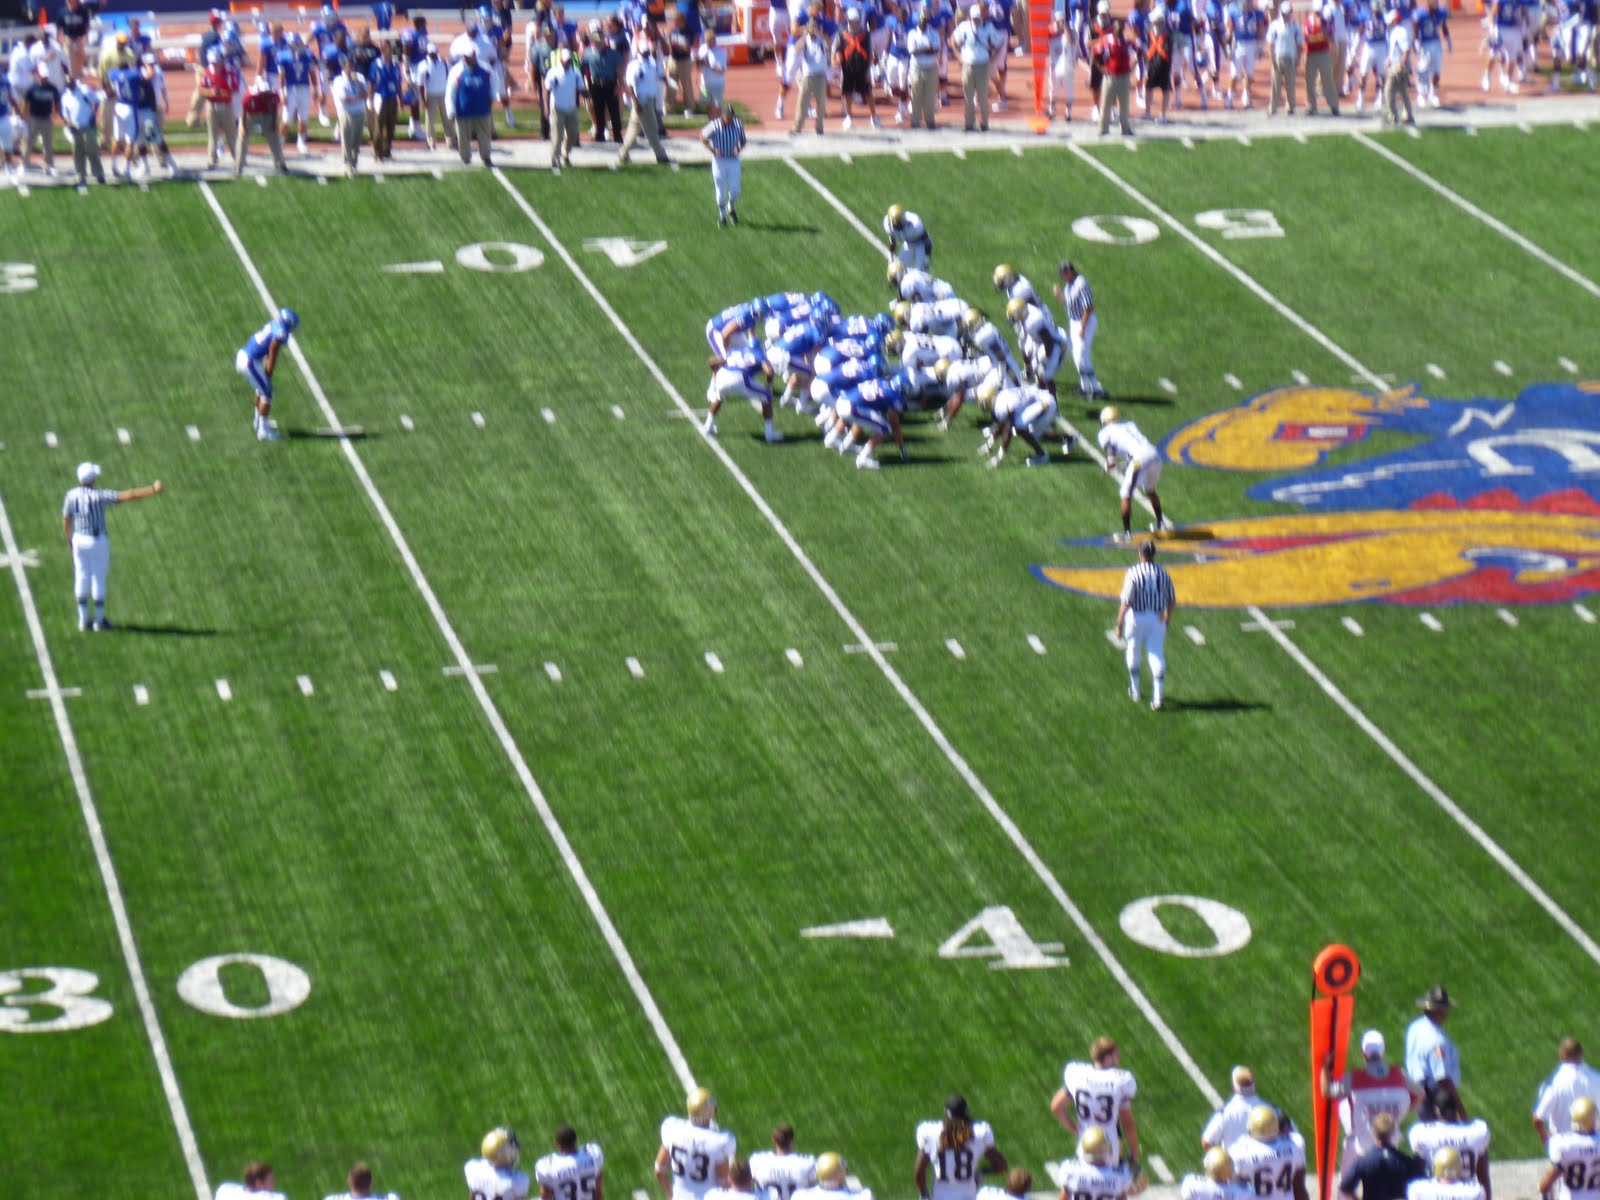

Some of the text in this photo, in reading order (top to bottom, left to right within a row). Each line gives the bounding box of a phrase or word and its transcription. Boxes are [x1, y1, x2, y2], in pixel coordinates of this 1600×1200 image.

[938, 894, 1252, 970] 40
[1076, 1091, 1114, 1124] 63
[671, 1144, 710, 1182] 53
[938, 1150, 974, 1182] 18
[1253, 1163, 1293, 1197] 64
